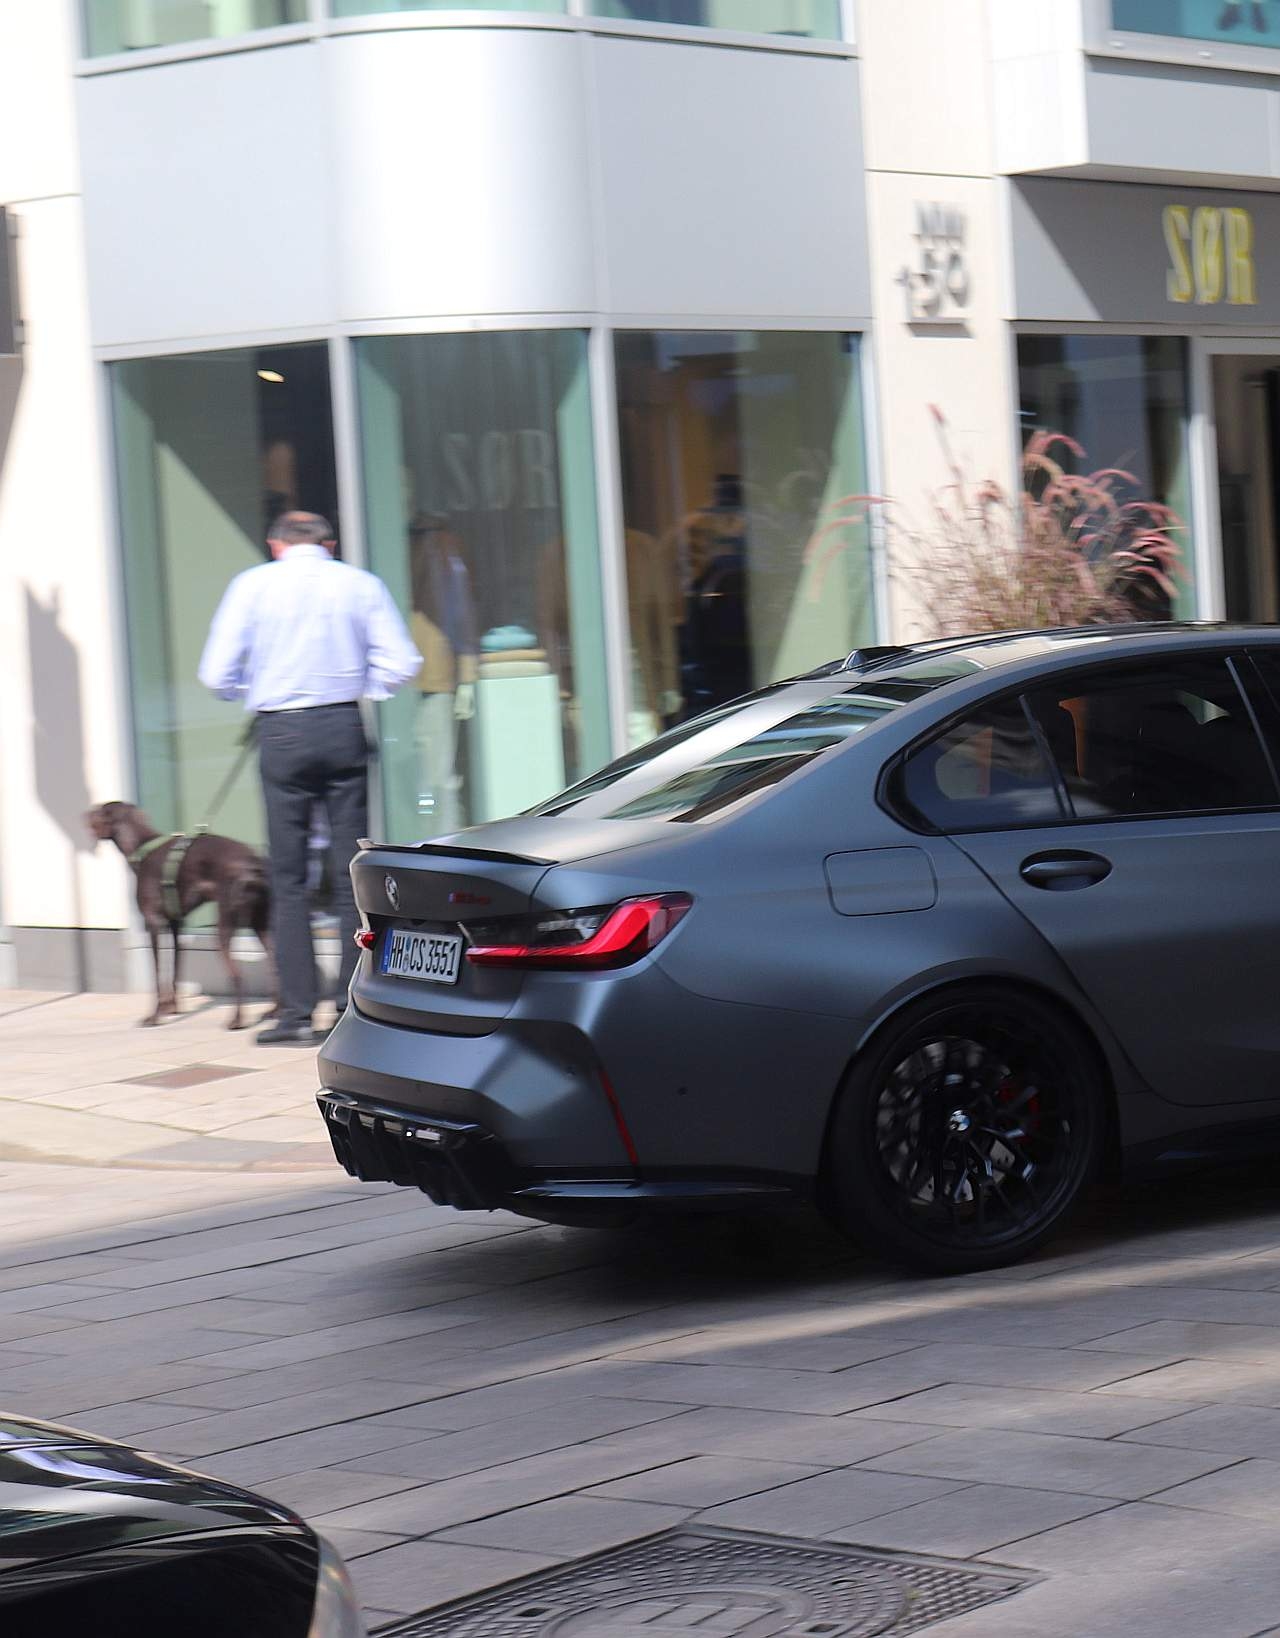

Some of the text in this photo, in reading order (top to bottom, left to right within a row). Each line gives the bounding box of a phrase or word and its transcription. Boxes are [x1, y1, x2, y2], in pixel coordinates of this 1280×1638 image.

[389, 935, 458, 977] HH CS 3551
